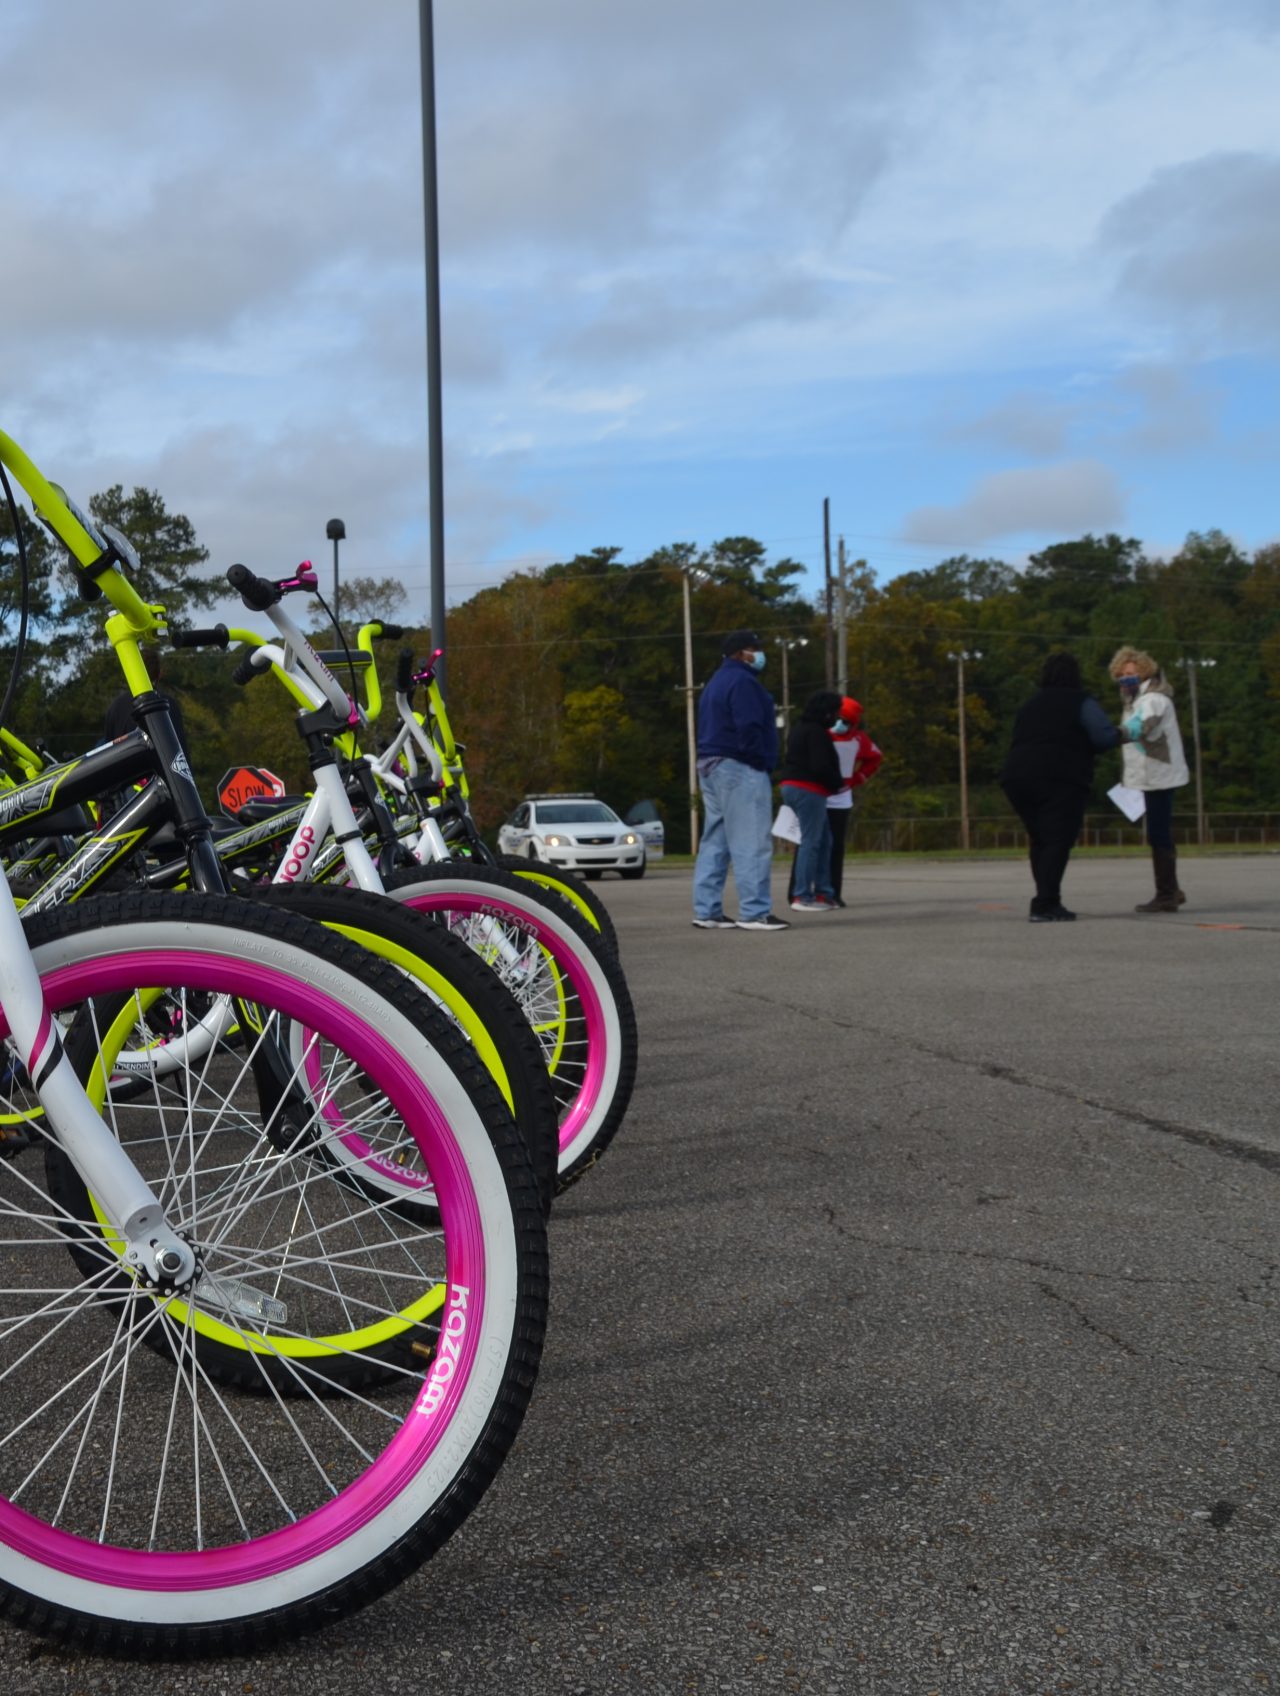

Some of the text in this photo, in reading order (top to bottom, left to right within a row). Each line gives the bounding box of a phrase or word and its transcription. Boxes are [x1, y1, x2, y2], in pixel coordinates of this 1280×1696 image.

[227, 784, 265, 808] SLOW
[479, 903, 541, 937] kazam
[416, 1283, 470, 1417] kazam
